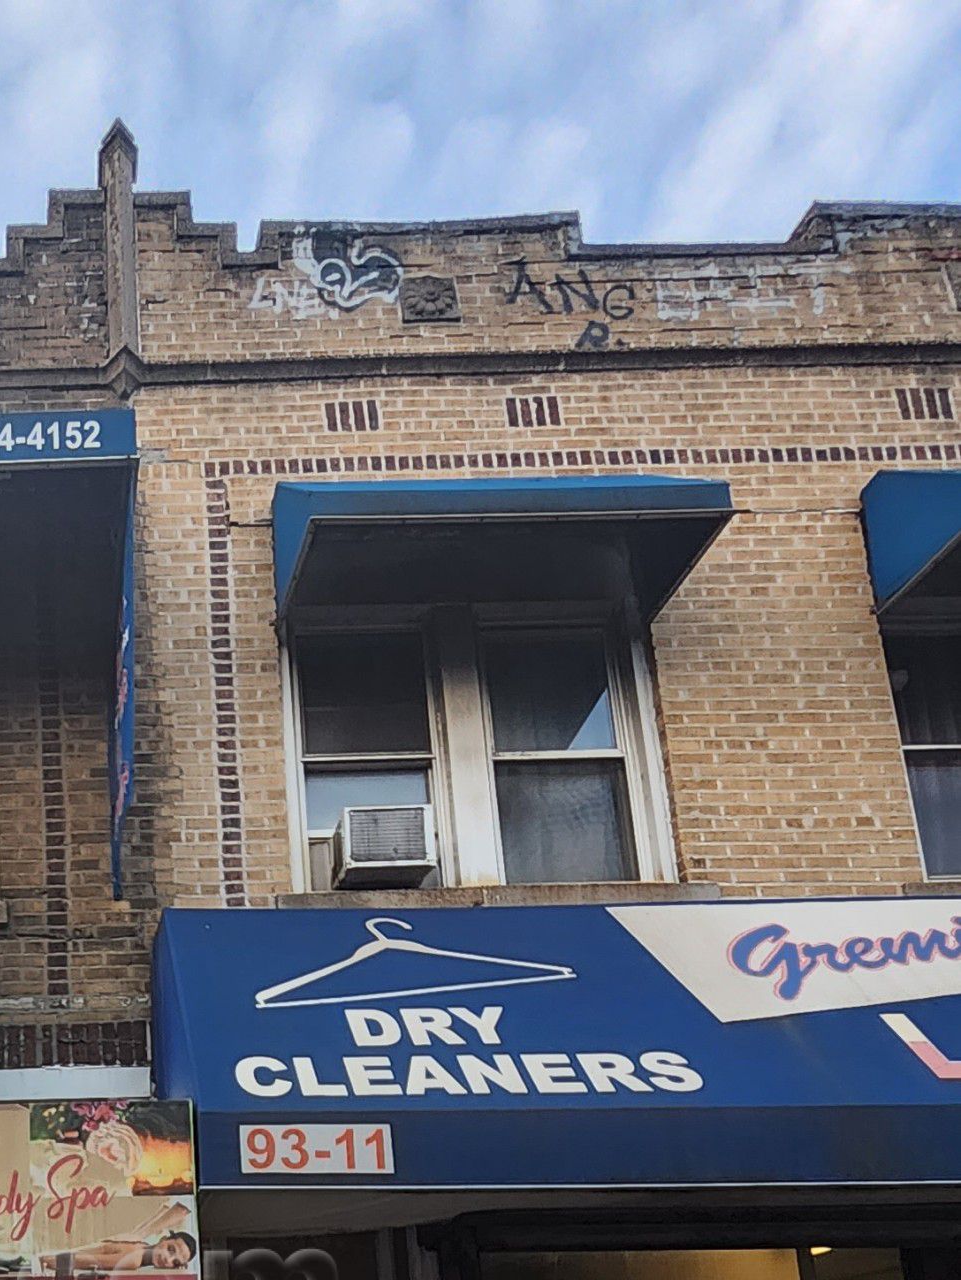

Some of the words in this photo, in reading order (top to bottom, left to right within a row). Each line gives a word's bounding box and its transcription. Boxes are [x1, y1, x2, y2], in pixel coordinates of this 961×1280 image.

[344, 1006, 504, 1047] DRY
[235, 1051, 704, 1097] CLEANERS
[246, 1128, 386, 1170] 93-11
[46, 1154, 116, 1234] Spa
